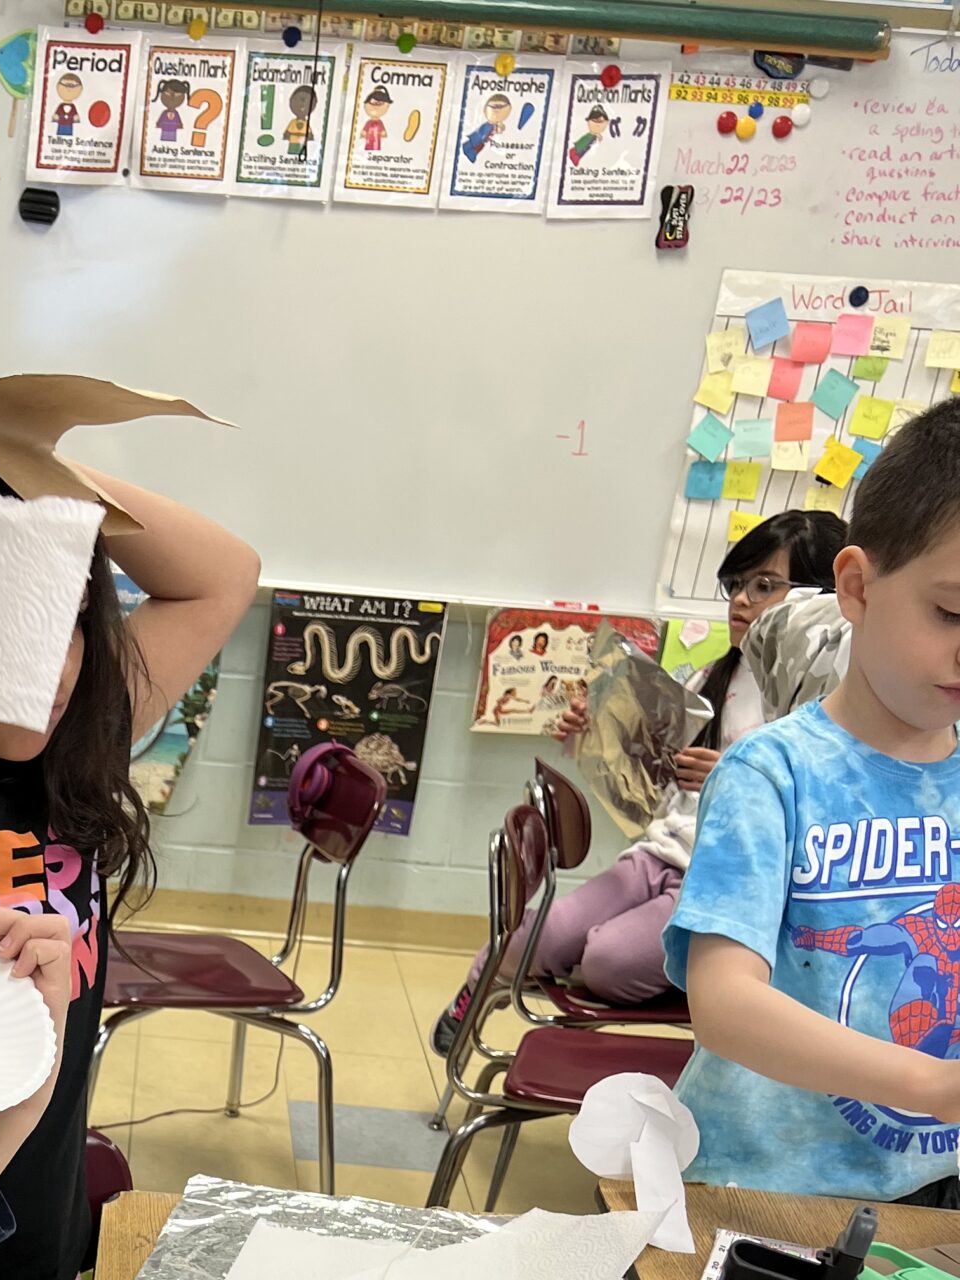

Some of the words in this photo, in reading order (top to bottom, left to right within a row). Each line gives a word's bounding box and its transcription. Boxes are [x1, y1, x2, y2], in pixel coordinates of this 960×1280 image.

[52, 49, 123, 73] Period
[153, 59, 198, 77] Question
[199, 61, 228, 79] Mark
[252, 61, 302, 83] Exclamation
[303, 65, 326, 84] Mark
[370, 67, 433, 87] Comma
[471, 75, 546, 97] Apostrophe
[678, 74, 691, 85] 42
[694, 75, 706, 85] 43
[708, 76, 721, 86] 44
[724, 77, 736, 88] 45
[739, 78, 752, 89] 46
[755, 79, 768, 90] 47
[770, 81, 783, 91] 48
[785, 81, 797, 92] 49
[576, 85, 620, 104] Quotation
[621, 86, 652, 104] Marks
[675, 90, 688, 100] 92
[691, 90, 704, 101] 93
[706, 91, 718, 102] 94
[721, 92, 734, 102] 95
[737, 94, 749, 104] 96
[767, 96, 780, 107] 98
[783, 97, 795, 107] 99
[863, 99, 916, 114] review
[47, 135, 73, 148] Telling
[75, 137, 113, 149] Sentence
[869, 124, 879, 135] a
[893, 123, 944, 143] spelling
[152, 144, 181, 157] Asking
[182, 146, 215, 157] Sentence
[490, 141, 535, 151] Possessor
[505, 151, 516, 160] or
[849, 145, 892, 162] read
[899, 151, 921, 162] an
[367, 152, 413, 165] Separator
[484, 160, 535, 171] Contraction
[674, 148, 725, 174] March
[760, 154, 797, 173] 2023
[569, 167, 600, 179] Talking
[866, 165, 936, 184] questions
[679, 193, 687, 215] OVER
[846, 187, 911, 207] compare
[671, 207, 679, 226] JUST
[845, 207, 918, 226] conduct
[931, 214, 955, 225] an
[676, 216, 684, 240] START
[841, 228, 881, 248] share
[792, 284, 847, 309] Word
[868, 290, 913, 314] Jail
[303, 595, 355, 613] WHAT
[359, 600, 386, 615] AM
[392, 600, 414, 618] I?
[493, 664, 536, 676] Famous
[540, 660, 581, 675] Women
[792, 814, 960, 888] SPIDER-
[872, 1123, 914, 1153] NEW
[711, 1261, 721, 1270] 20
[717, 1244, 727, 1252] 21
